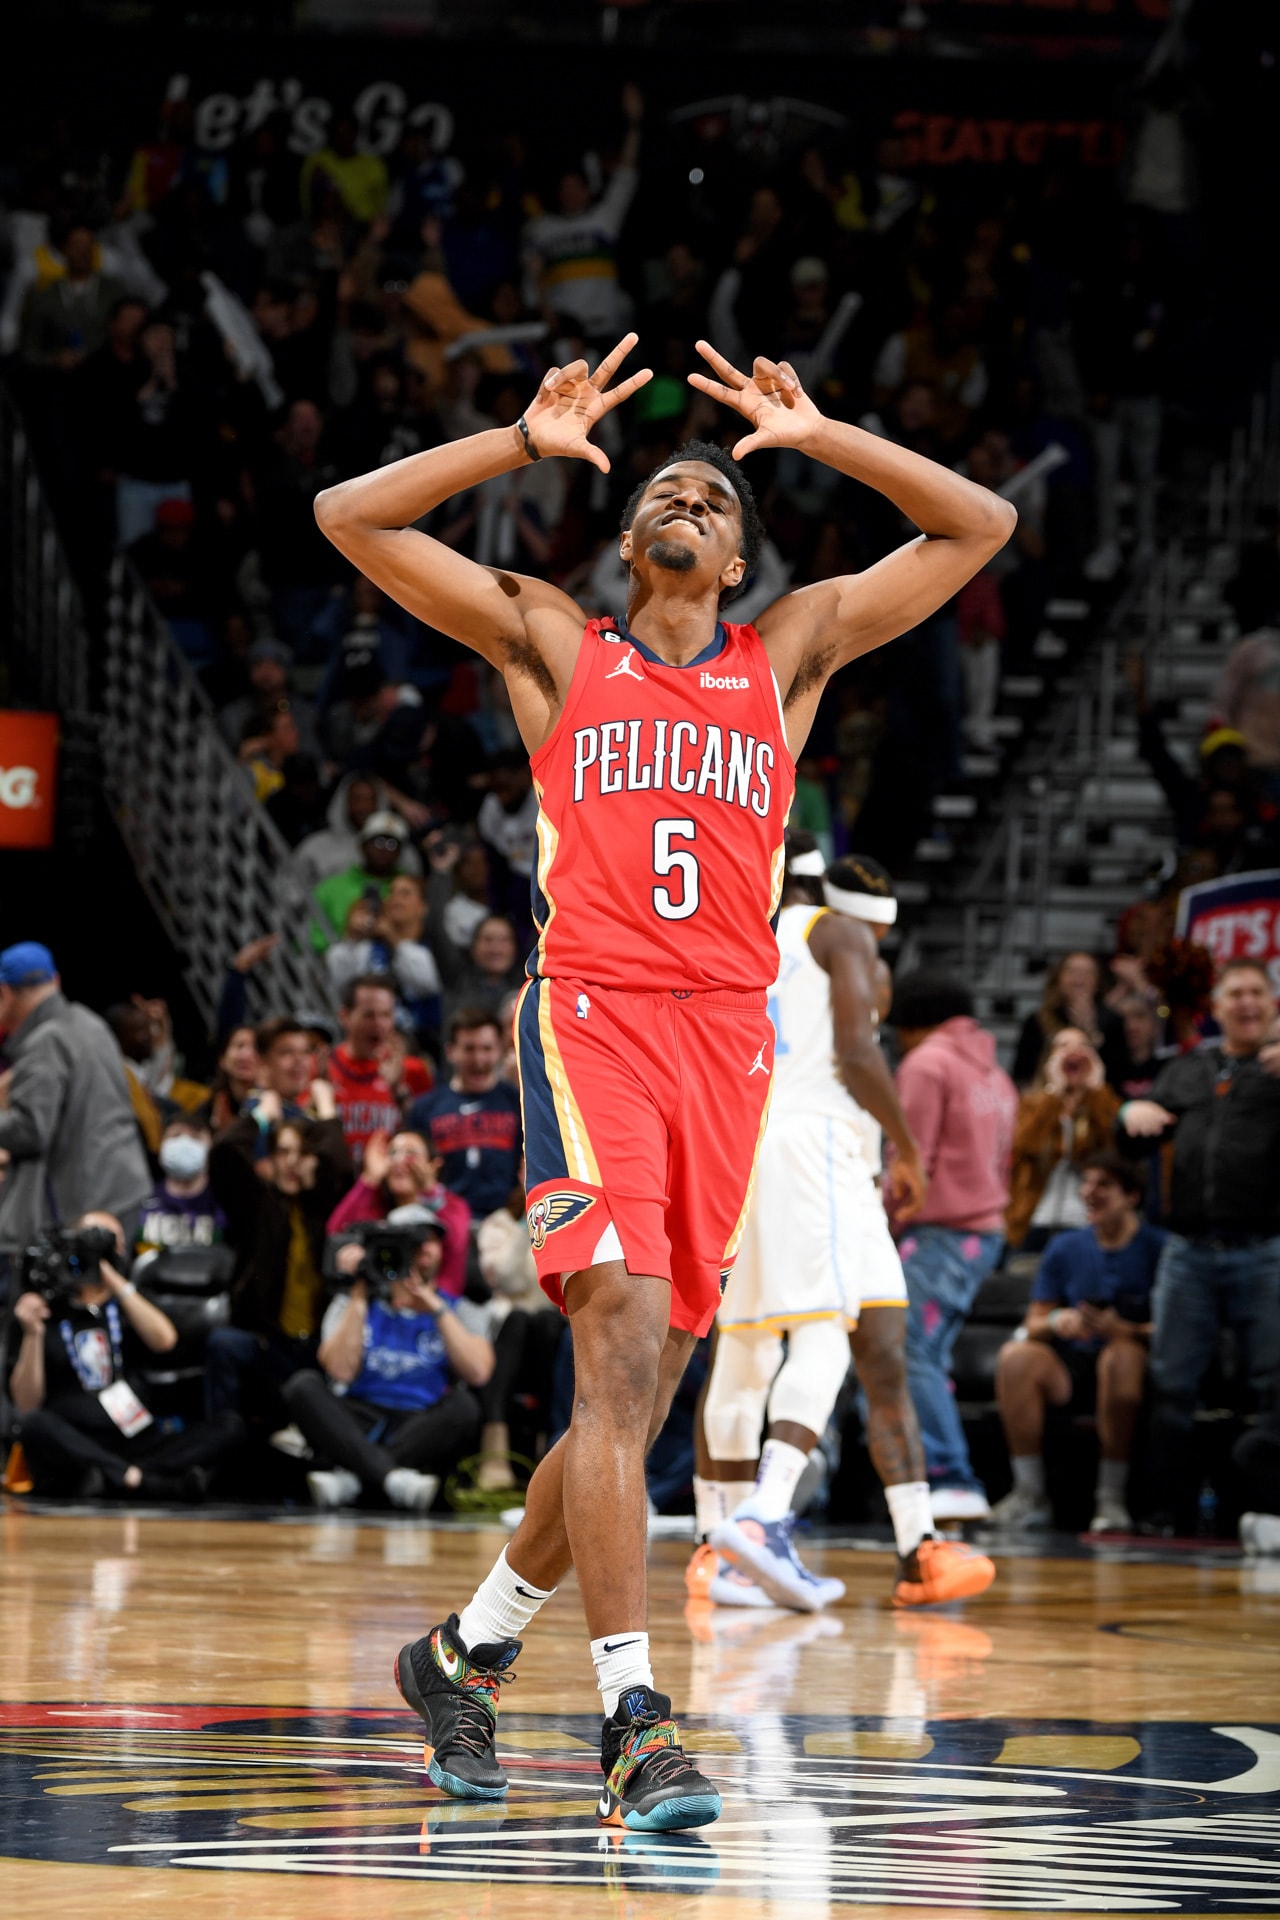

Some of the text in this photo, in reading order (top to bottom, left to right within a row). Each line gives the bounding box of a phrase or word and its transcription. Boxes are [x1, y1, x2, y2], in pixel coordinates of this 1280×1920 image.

[700, 672, 750, 691] ibotta
[572, 718, 776, 819] PELICANS
[652, 817, 700, 921] 5
